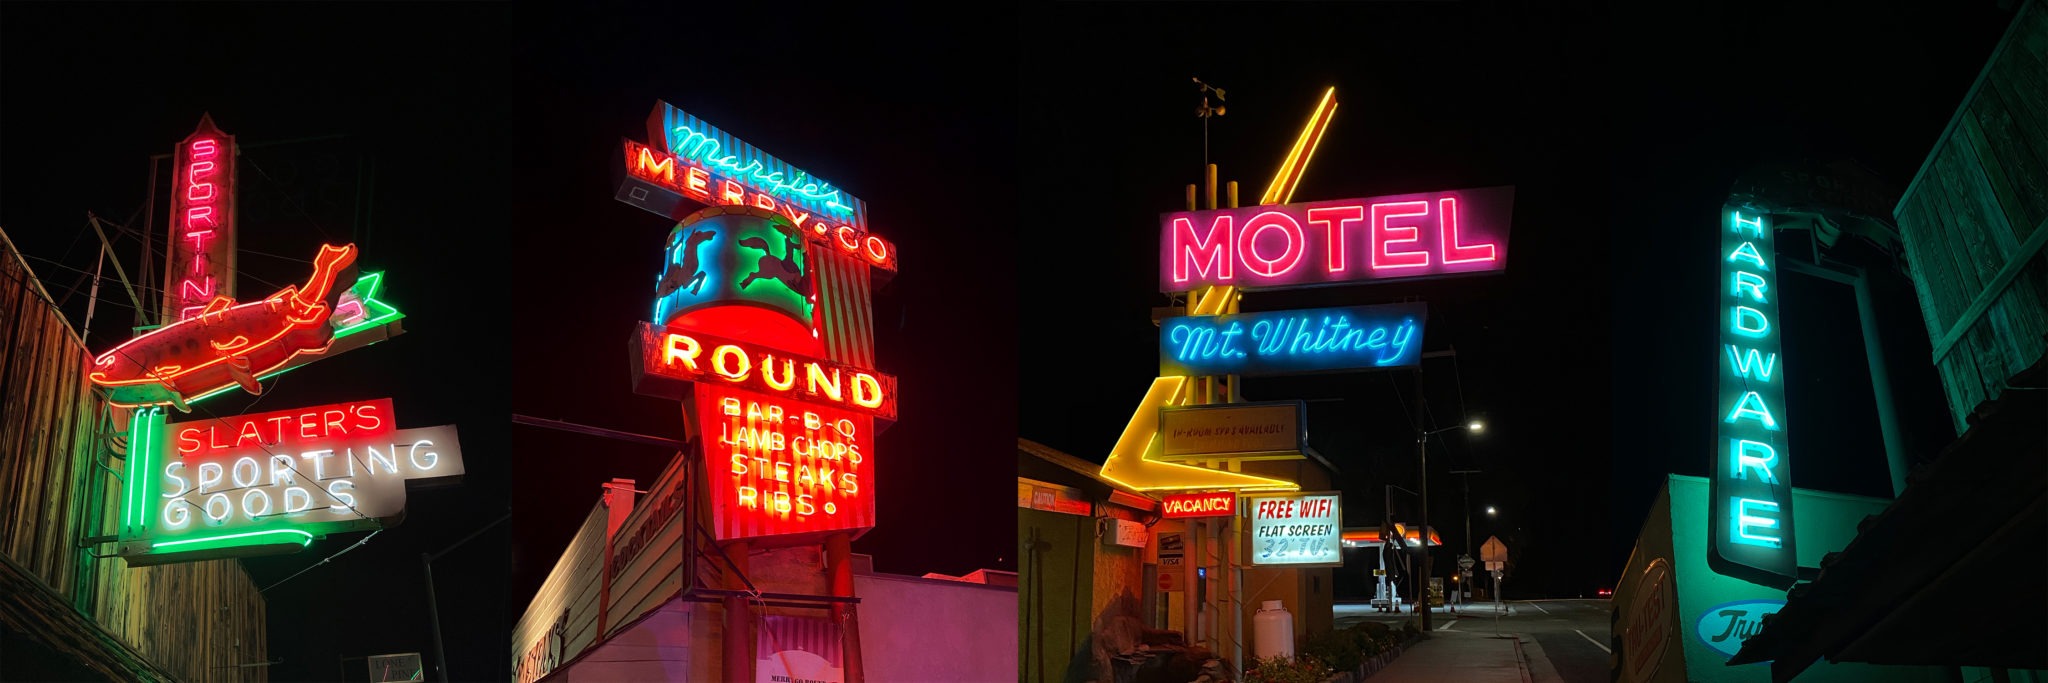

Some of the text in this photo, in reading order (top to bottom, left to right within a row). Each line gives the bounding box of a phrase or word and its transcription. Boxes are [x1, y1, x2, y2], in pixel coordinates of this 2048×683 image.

[672, 126, 854, 216] Margie's
[1173, 198, 1495, 282] MOTEL
[1171, 316, 1415, 365] Mt. Whitney
[661, 333, 884, 409] ROUND
[1725, 210, 1782, 549] HARDWARE
[178, 405, 381, 453] SLATER'S
[722, 422, 863, 464] LAMB CHOPS
[723, 397, 856, 442] BAR-B-Q
[161, 439, 440, 499] SPORTING
[731, 454, 859, 494] STEAKS
[161, 480, 358, 530] GOODS
[1164, 497, 1231, 514] VACANCY
[1258, 498, 1333, 520] FREE WIFI
[1258, 524, 1333, 538] FLAT SCREEN
